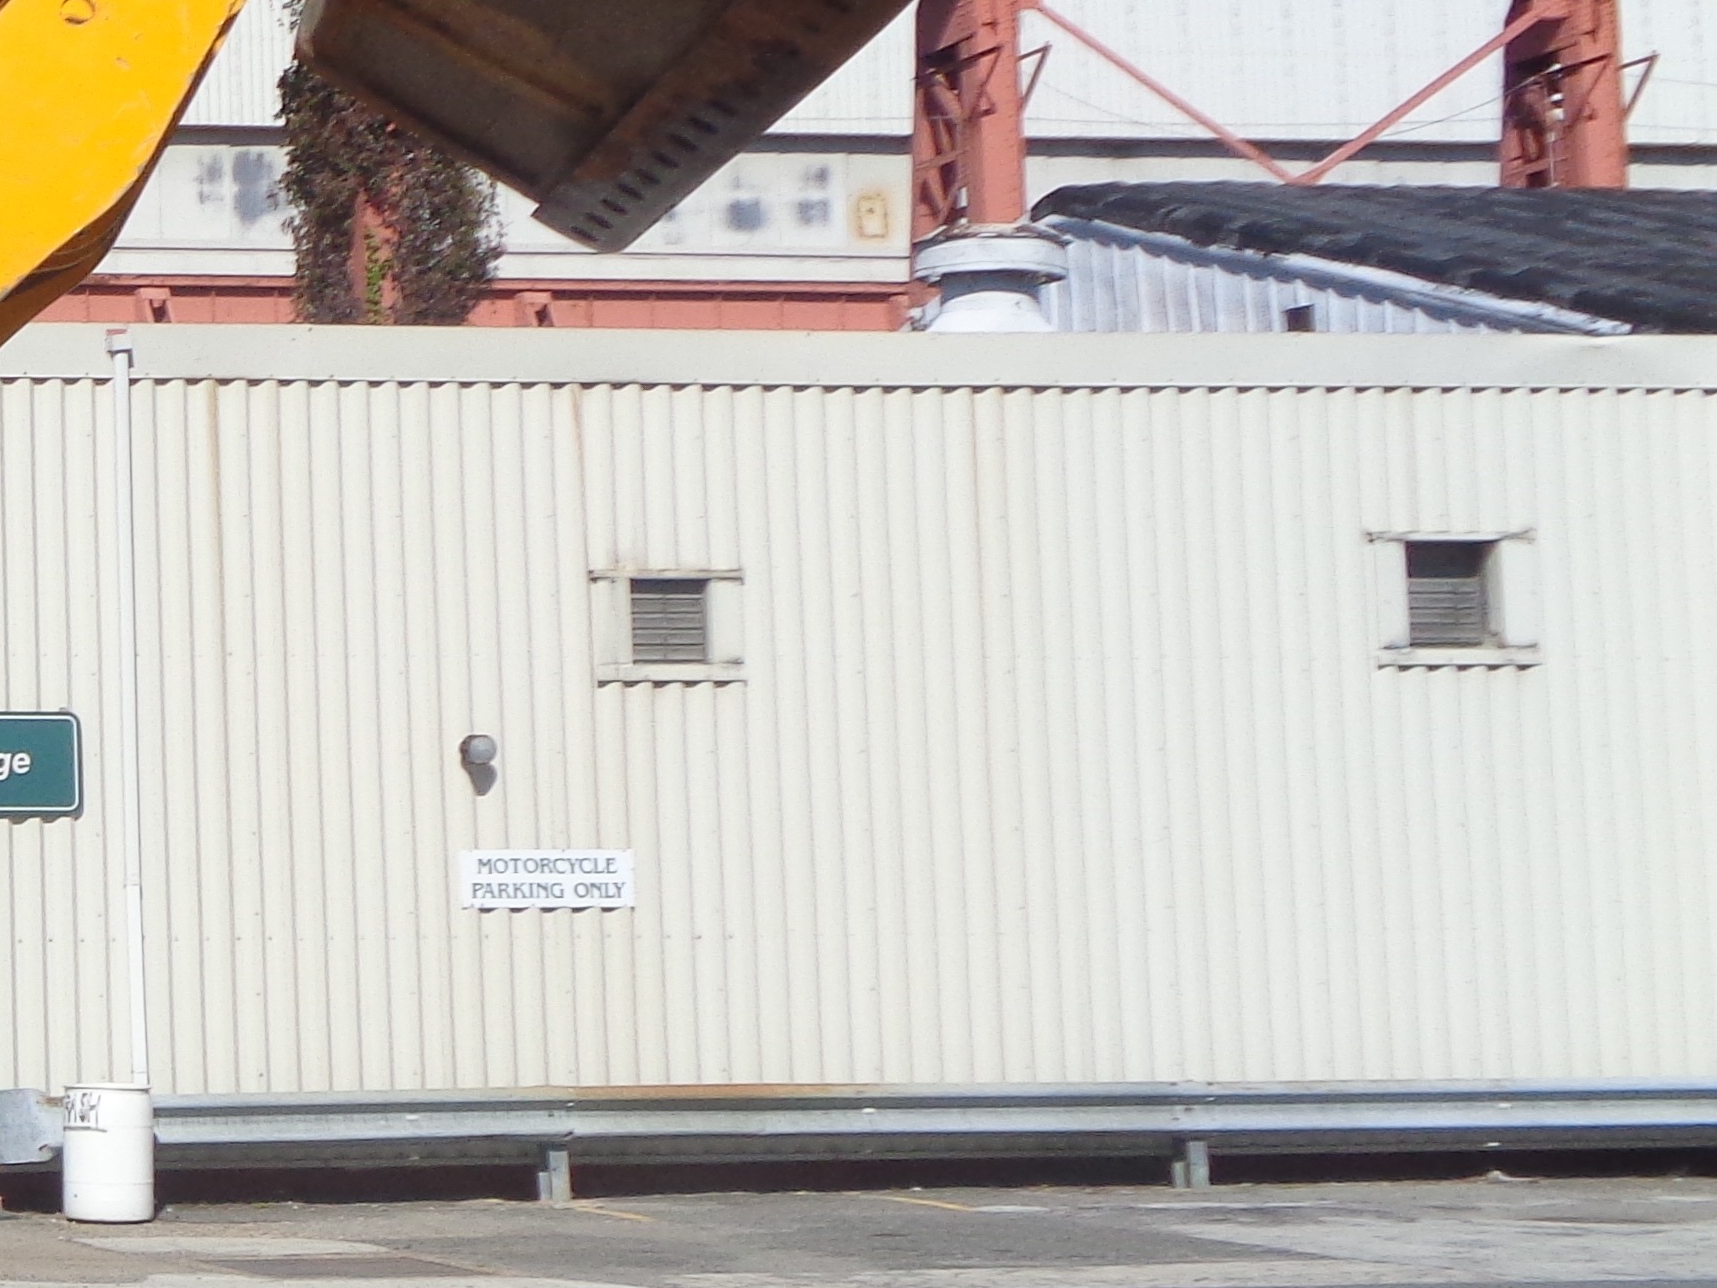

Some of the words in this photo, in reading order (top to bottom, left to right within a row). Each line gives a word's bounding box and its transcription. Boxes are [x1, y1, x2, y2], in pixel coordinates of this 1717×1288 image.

[476, 857, 618, 874] MOTORCYCLE
[471, 882, 565, 899] PARKING
[573, 882, 626, 899] ONLY
